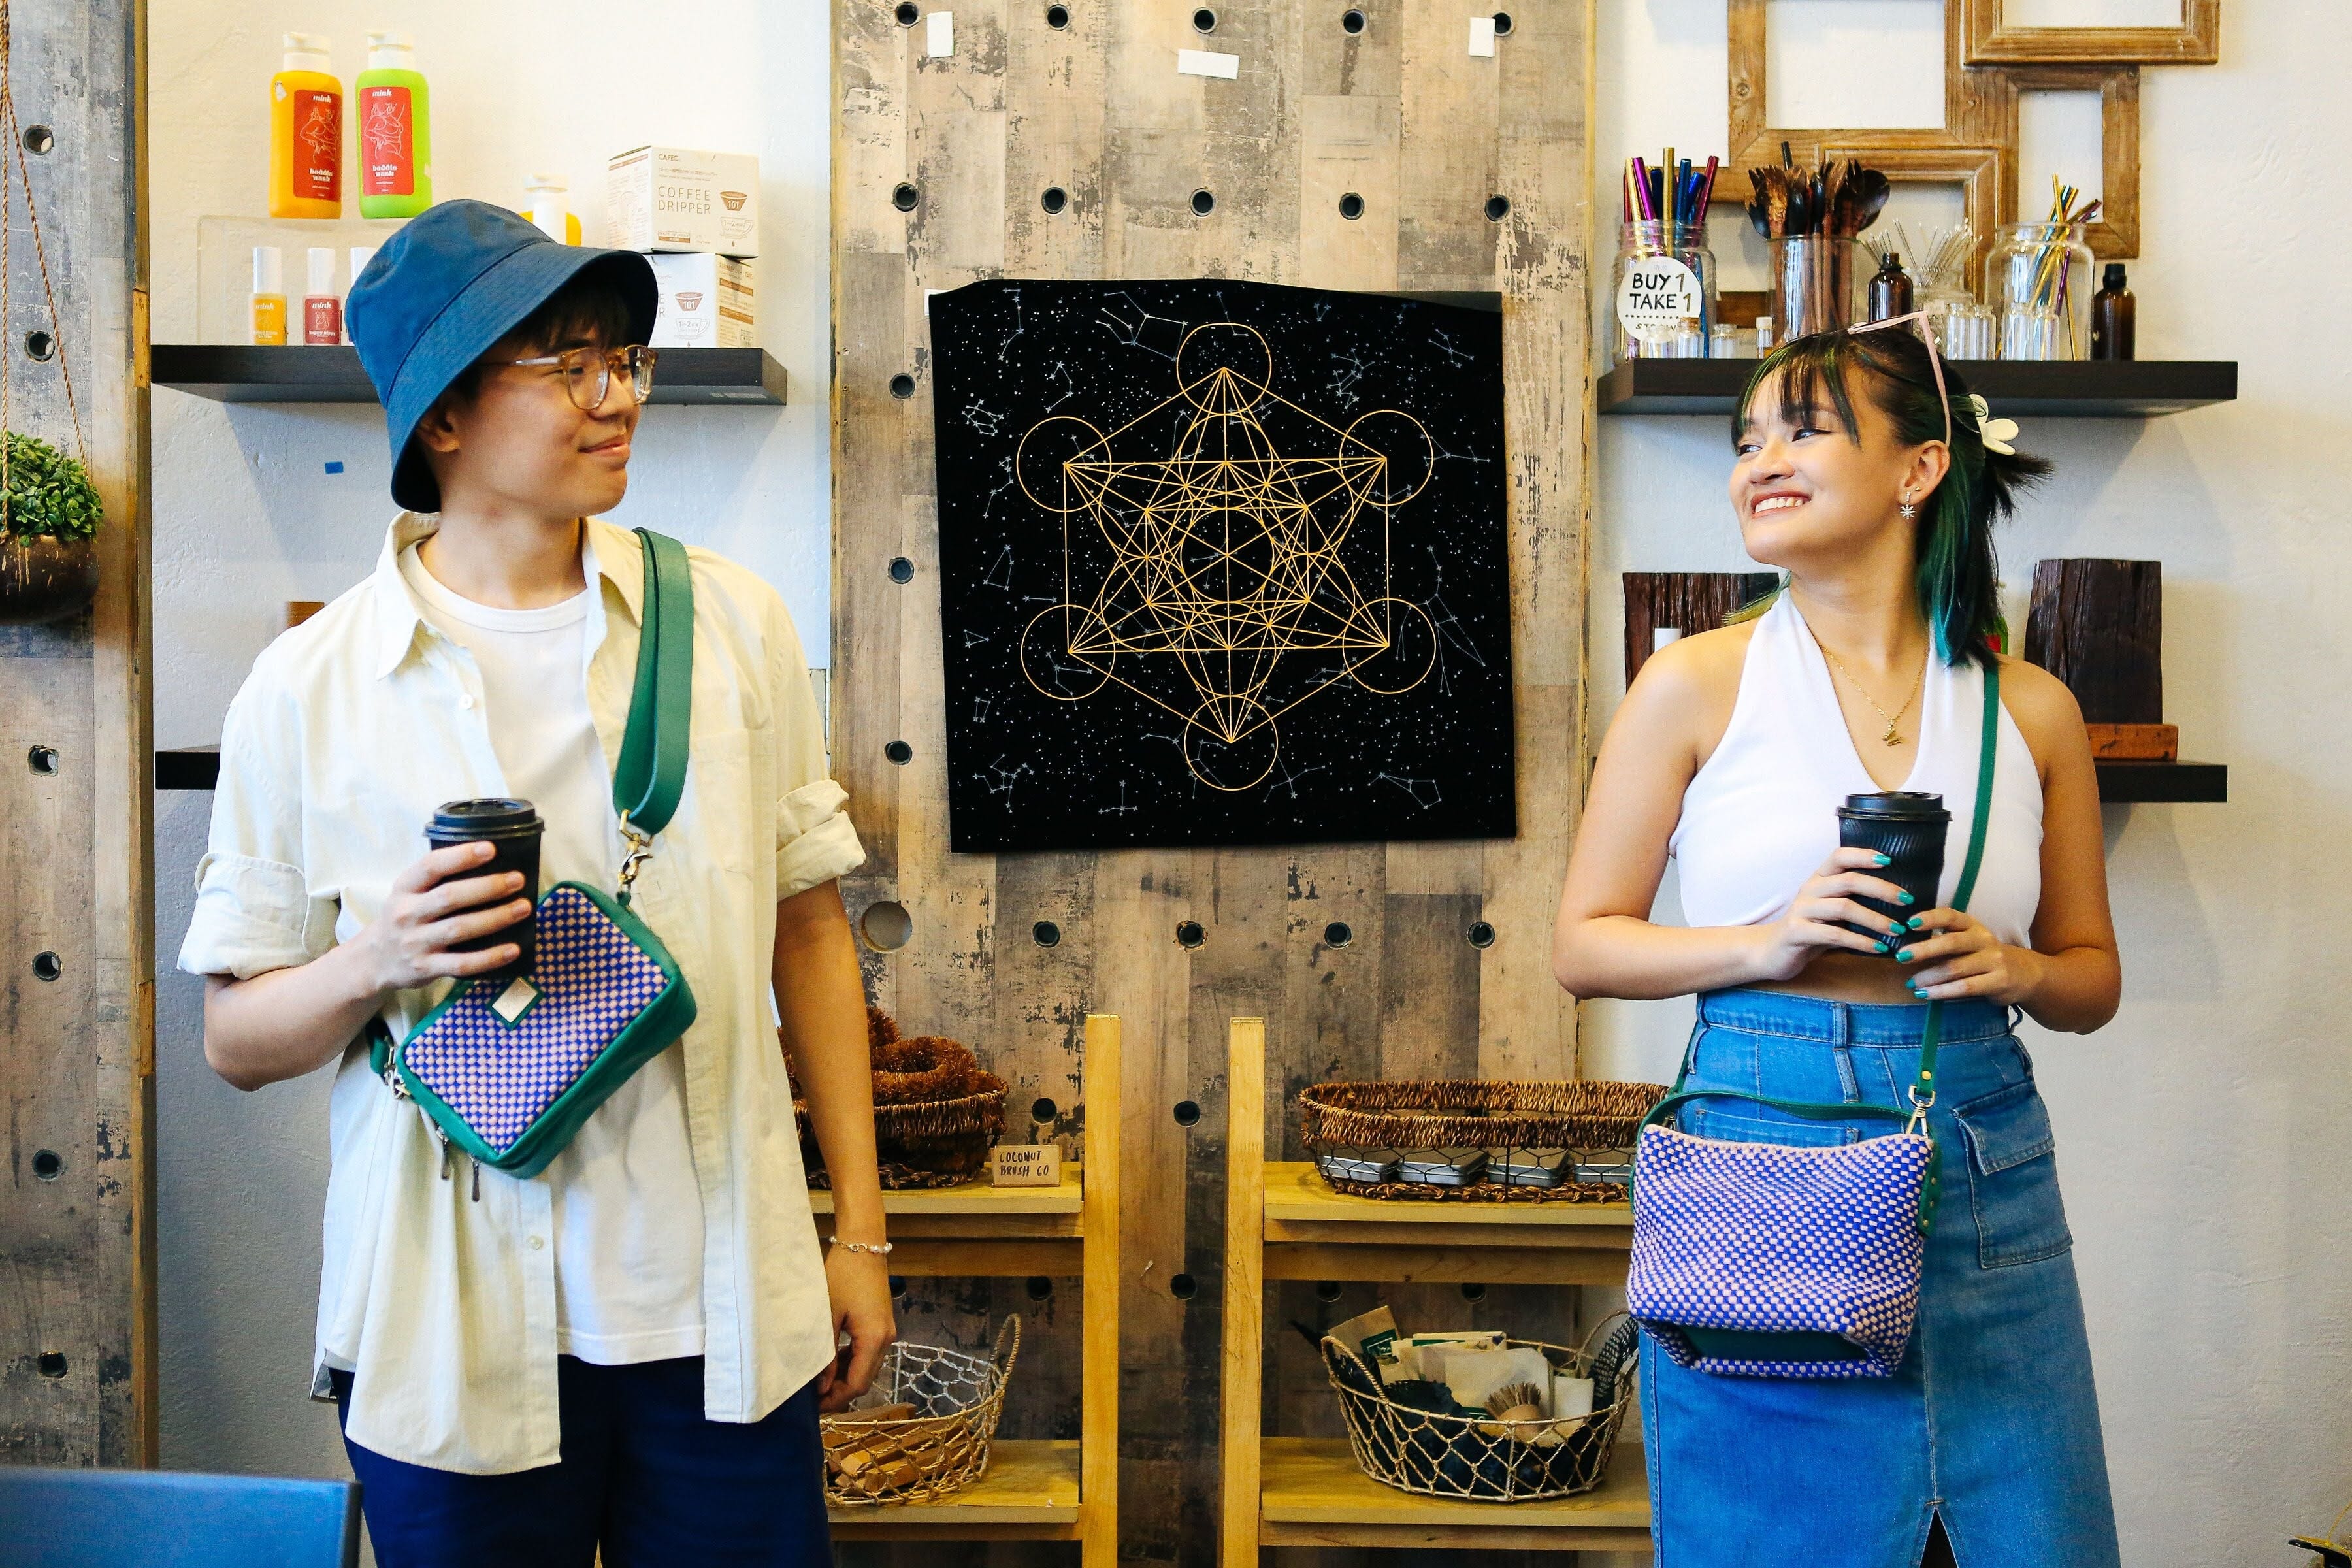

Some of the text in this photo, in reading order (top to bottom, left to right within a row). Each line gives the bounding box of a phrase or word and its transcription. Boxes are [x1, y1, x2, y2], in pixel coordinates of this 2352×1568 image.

[658, 186, 711, 201] COFFEE
[658, 200, 711, 214] DRIPPER
[728, 200, 740, 208] 101
[1632, 272, 1685, 293] BUY 1
[683, 301, 695, 310] 101
[1629, 293, 1691, 312] TAKE 1
[1000, 1150, 1042, 1163] COCONUT
[1000, 1164, 1030, 1177] BRUSH
